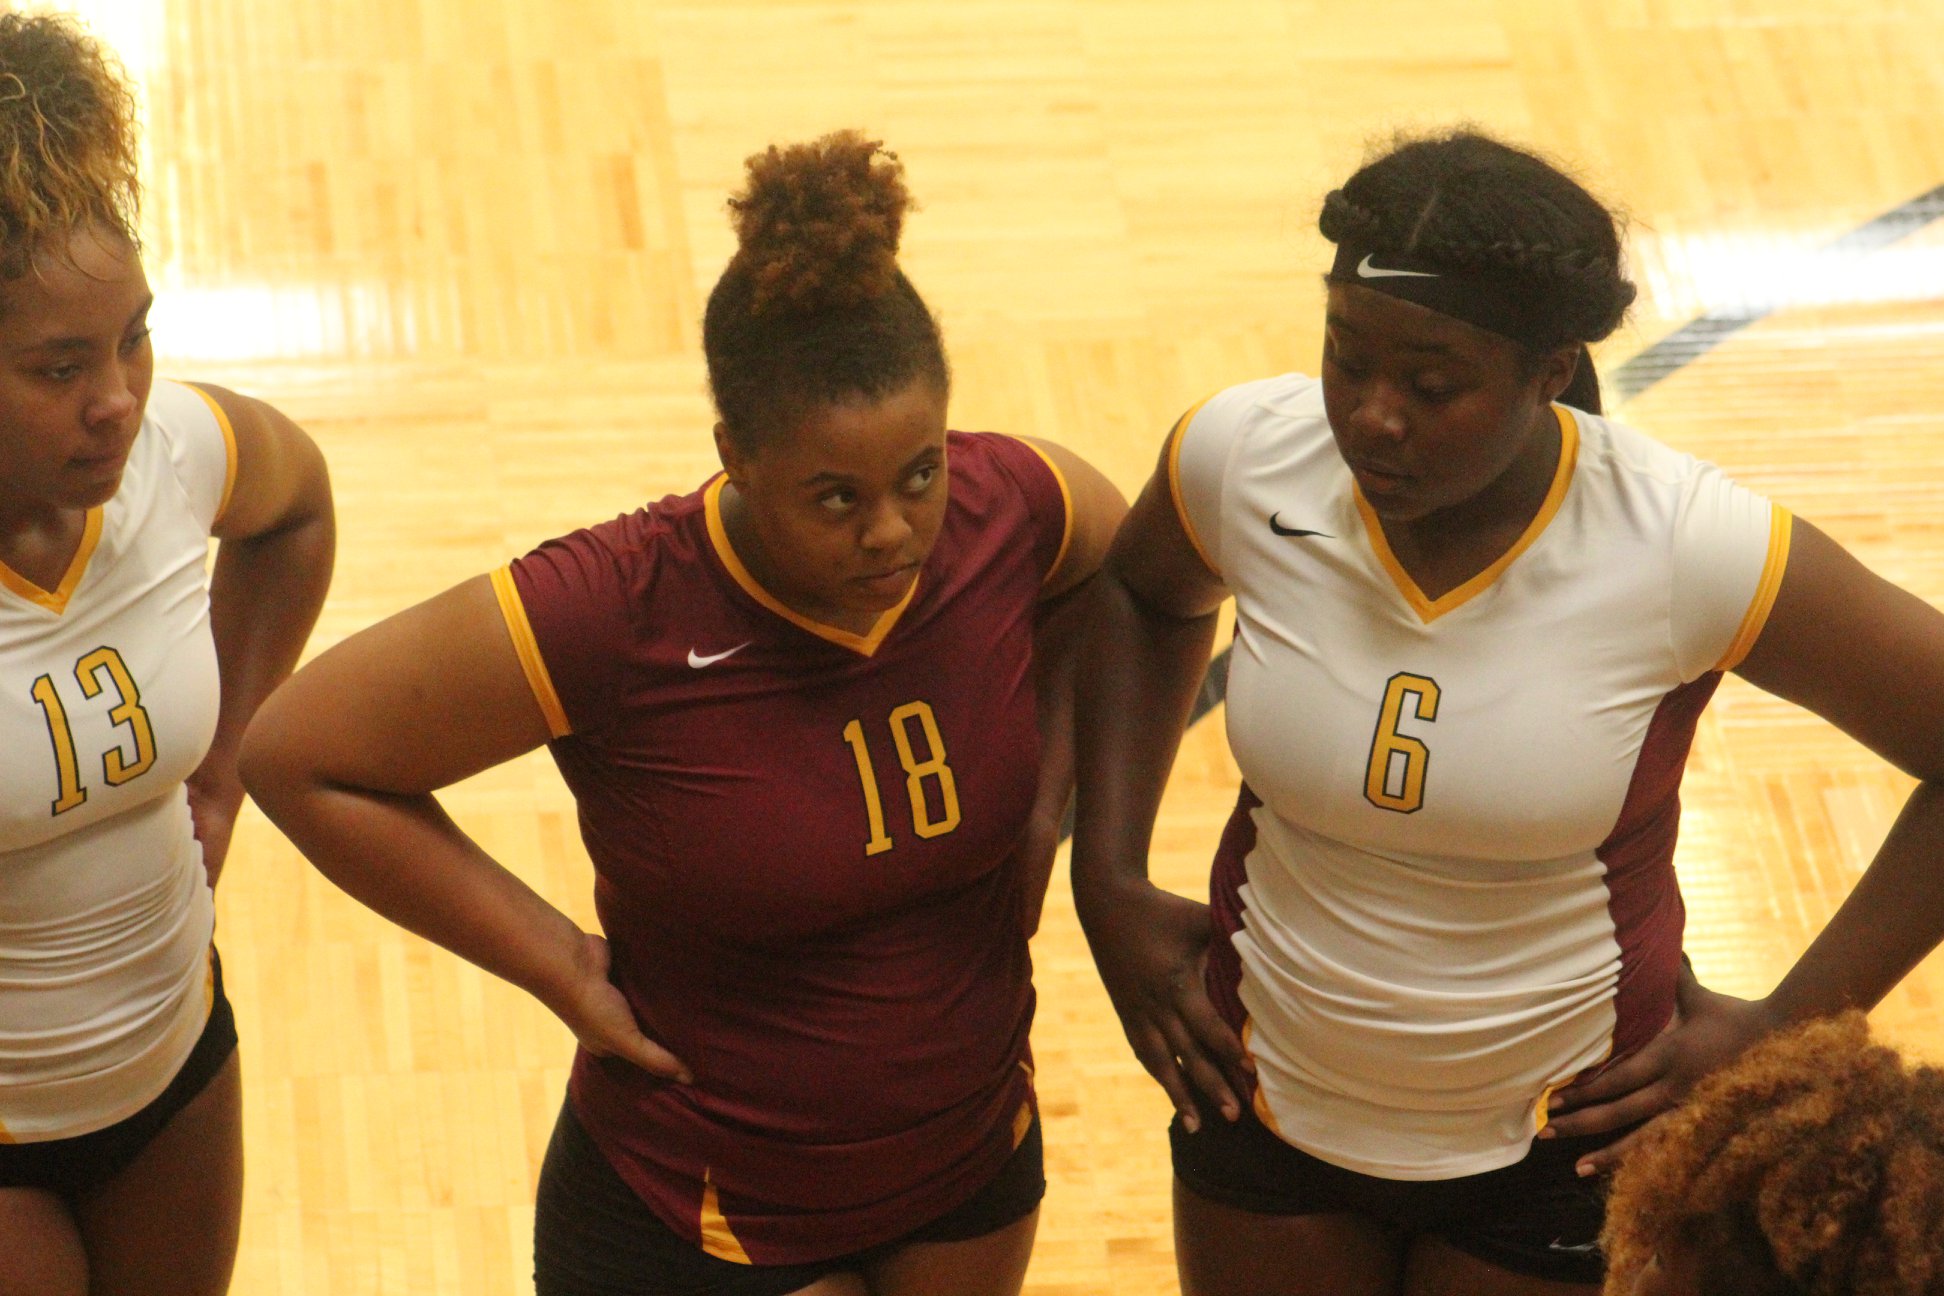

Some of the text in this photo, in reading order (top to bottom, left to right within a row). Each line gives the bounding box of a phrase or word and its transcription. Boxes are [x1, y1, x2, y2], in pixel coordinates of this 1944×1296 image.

[31, 645, 157, 817] 13
[842, 699, 962, 858] 18
[1363, 671, 1442, 814] 6
